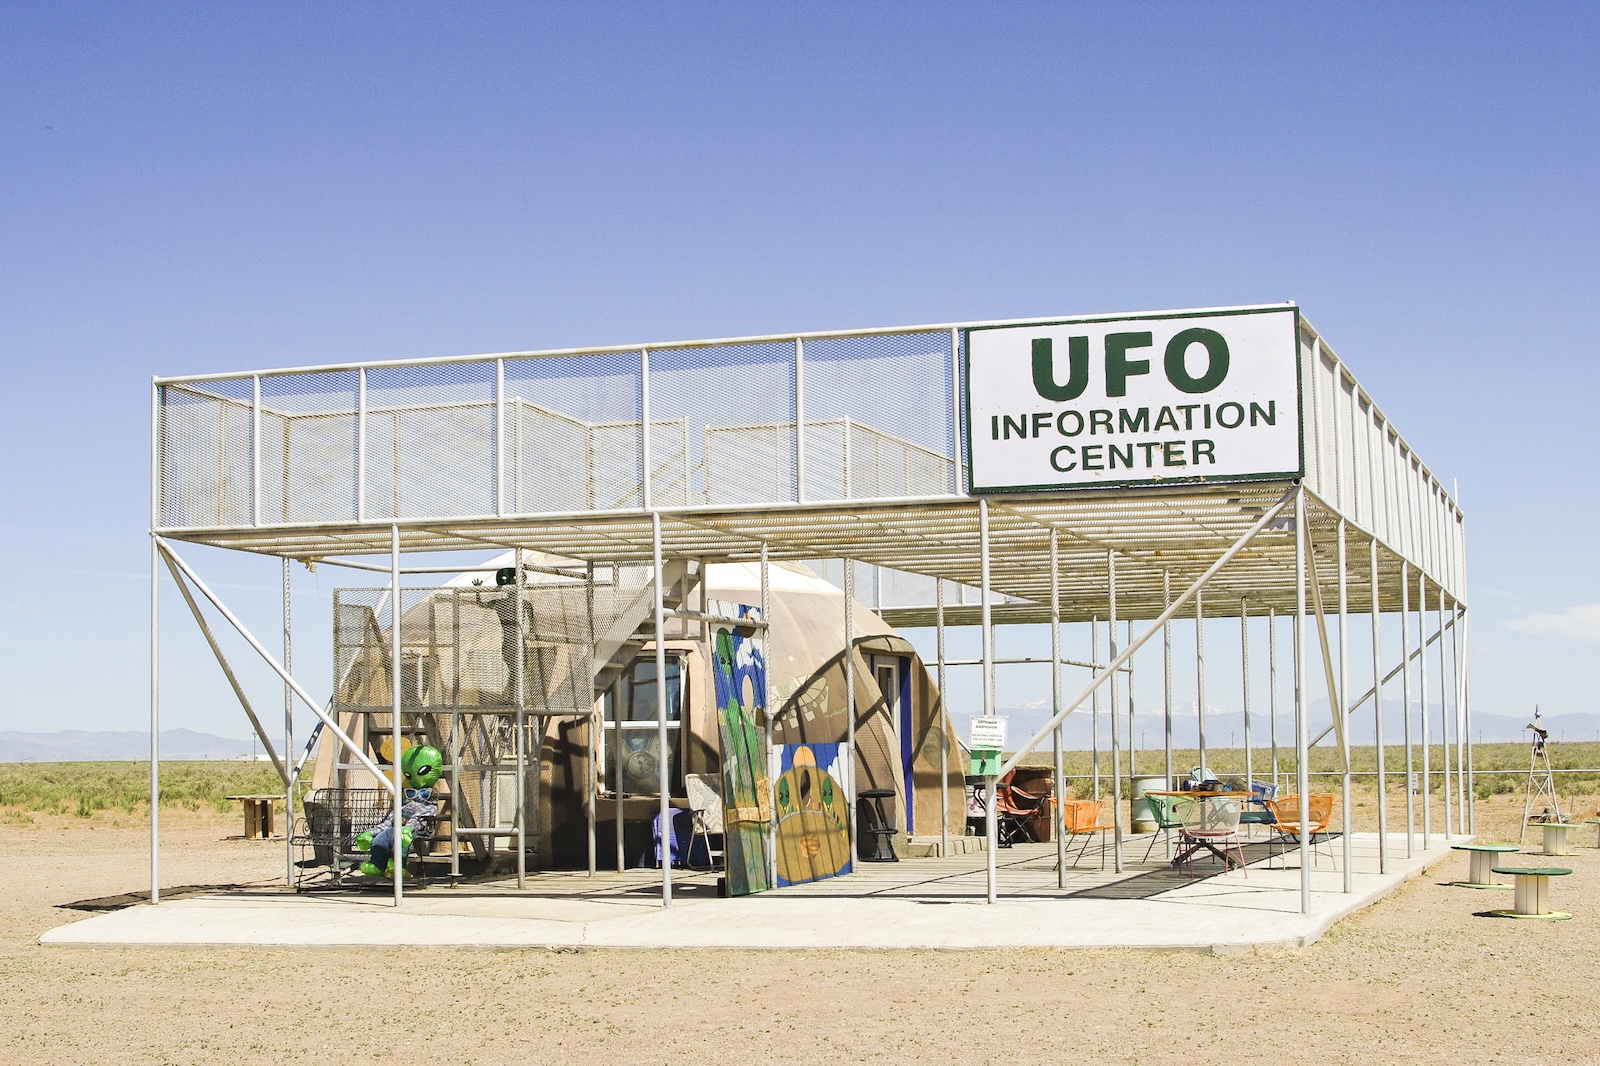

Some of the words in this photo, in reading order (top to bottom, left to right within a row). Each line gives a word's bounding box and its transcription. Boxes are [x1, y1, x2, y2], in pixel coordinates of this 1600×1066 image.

[1031, 327, 1231, 402] UFO
[991, 400, 1277, 440] INFORMATION
[1050, 439, 1216, 473] CENTER
